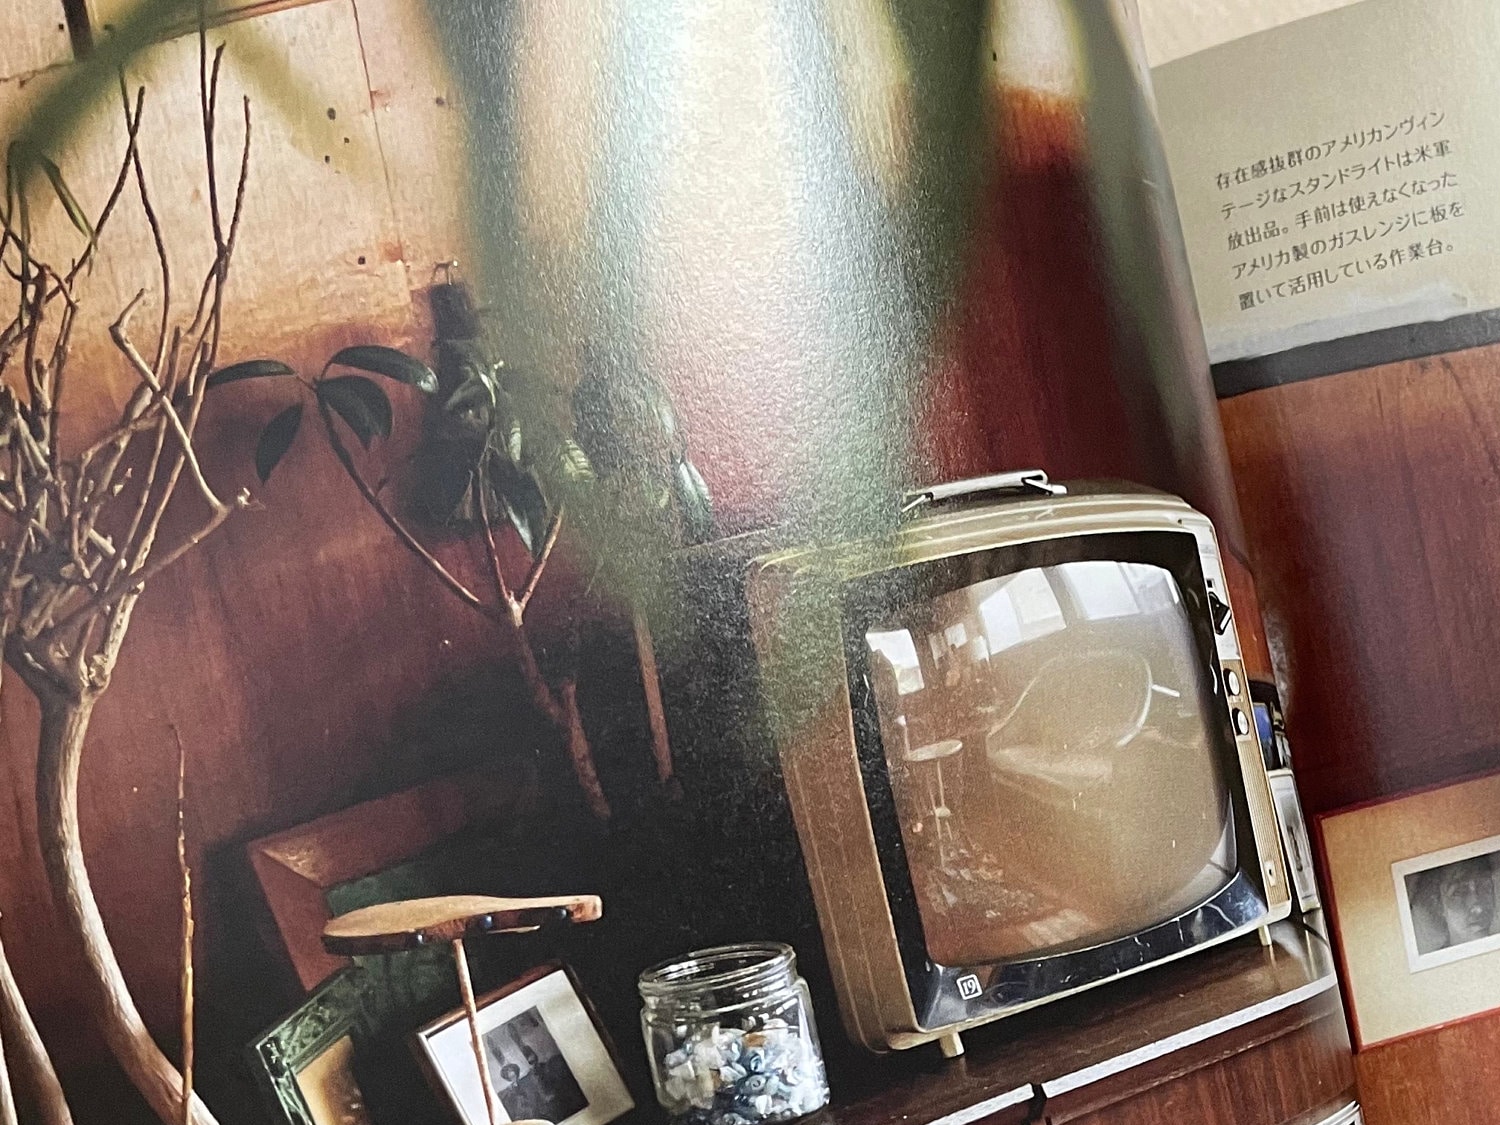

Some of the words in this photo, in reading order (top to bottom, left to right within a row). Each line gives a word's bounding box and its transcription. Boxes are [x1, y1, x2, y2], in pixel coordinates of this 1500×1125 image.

[1215, 110, 1446, 191] 存在感抜群のアメリカンヴィン
[1221, 139, 1453, 220] テージなスタンドライトは米軍
[1227, 171, 1459, 251] 放出品。手前は使えなくなった
[1231, 201, 1465, 280] アメリカ製のガスレンジに板を
[1239, 238, 1454, 311] 置いて活用している作業台。
